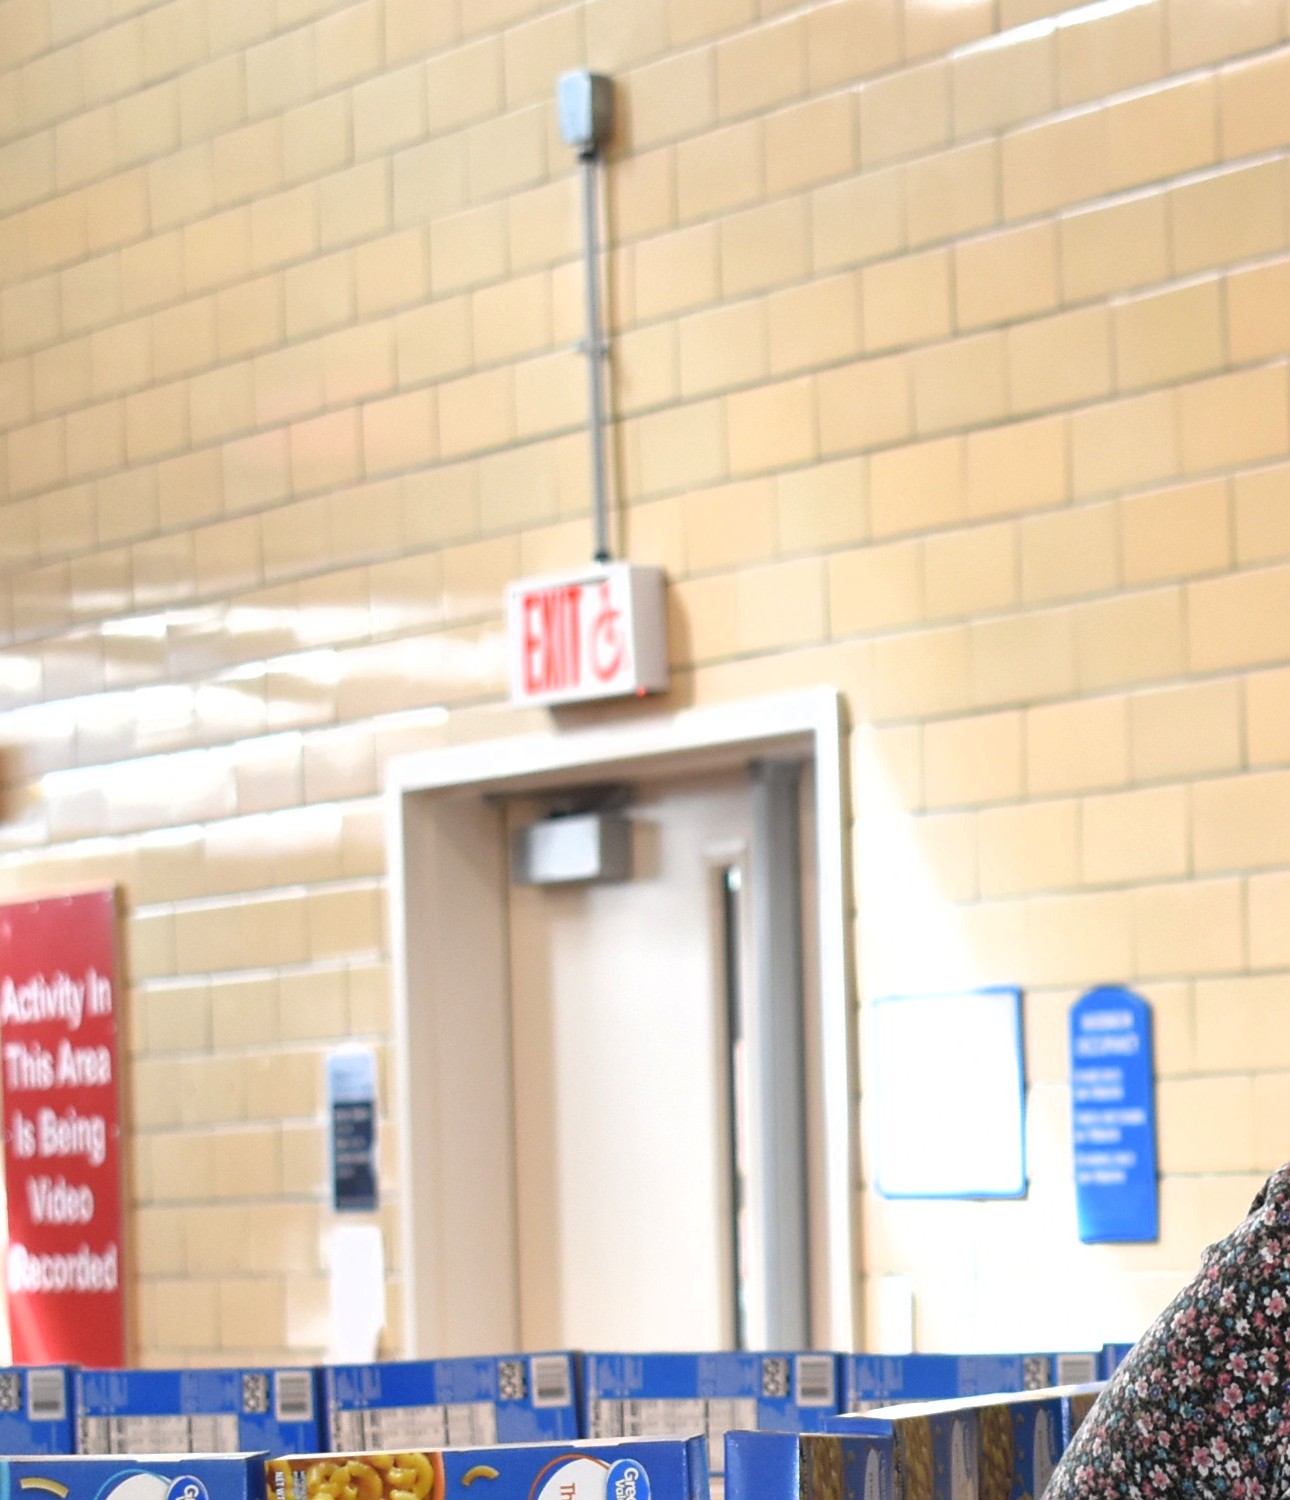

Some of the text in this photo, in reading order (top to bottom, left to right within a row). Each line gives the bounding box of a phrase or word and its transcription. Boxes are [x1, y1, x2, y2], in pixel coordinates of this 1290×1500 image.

[523, 584, 583, 696] EXIT
[1, 965, 112, 1030] Activity In
[5, 1038, 111, 1090] This Area
[12, 1106, 106, 1167] Is Being
[26, 1175, 94, 1224] Video
